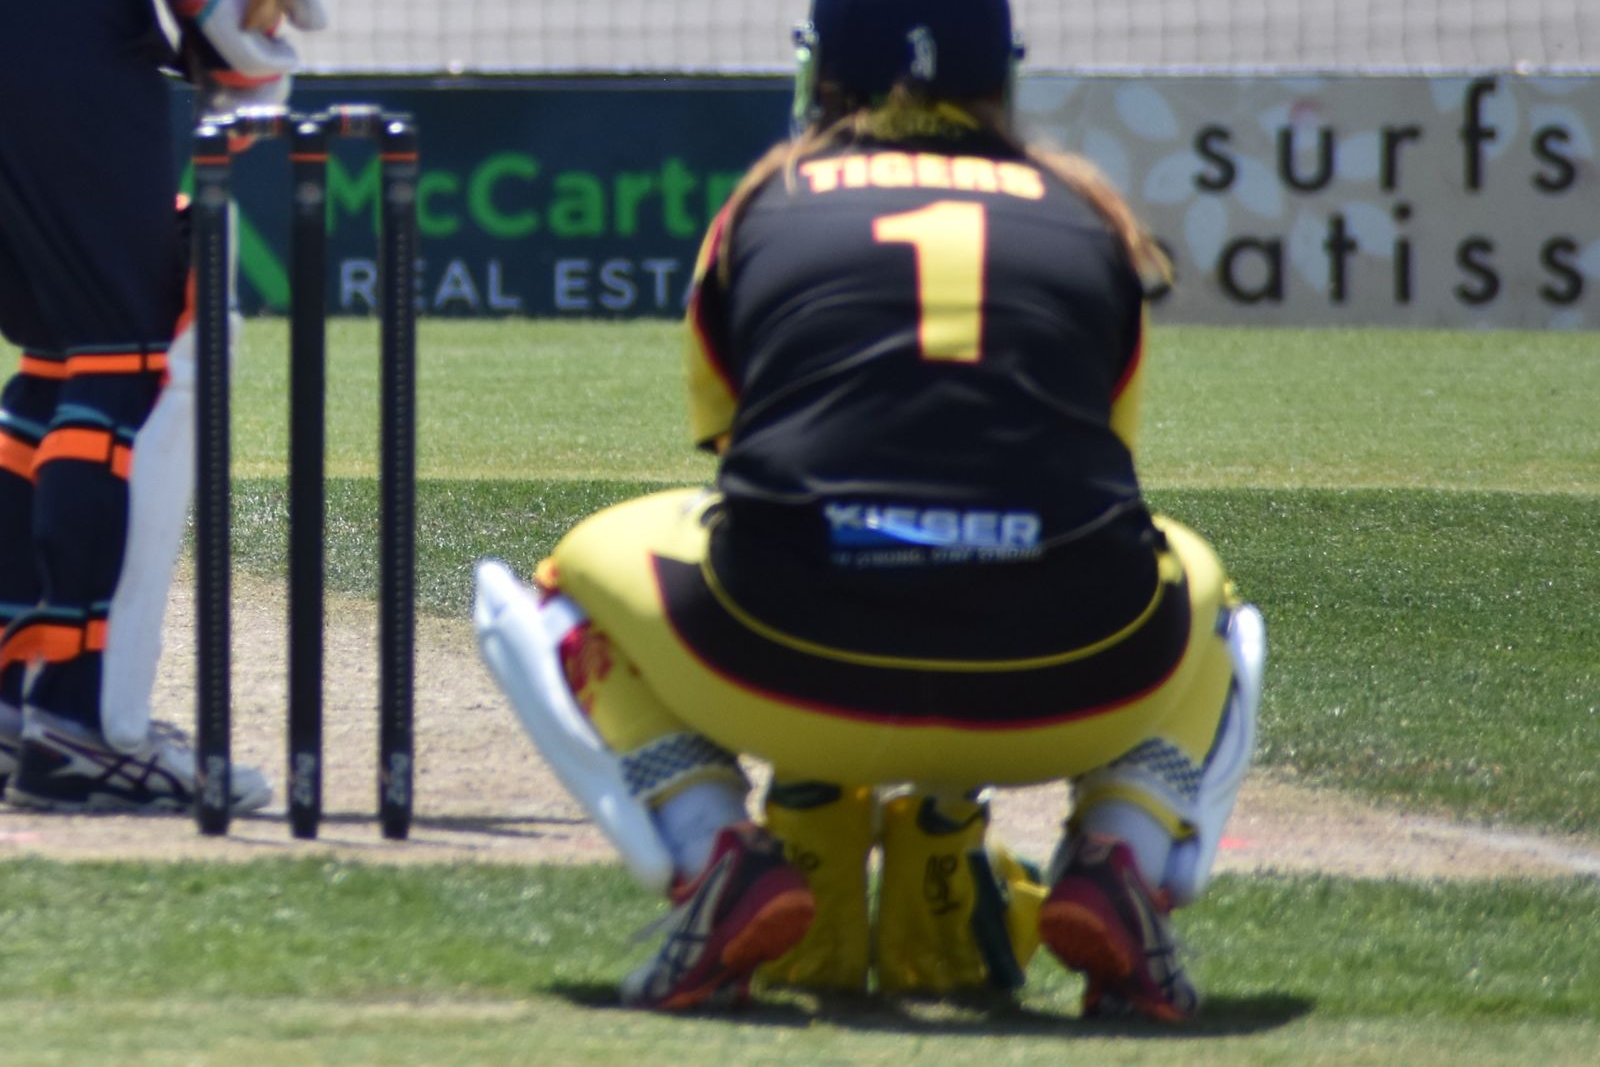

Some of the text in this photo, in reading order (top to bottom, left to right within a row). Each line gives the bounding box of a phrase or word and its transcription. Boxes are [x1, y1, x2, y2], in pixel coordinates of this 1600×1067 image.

[338, 258, 700, 308] RAL EST
[871, 200, 986, 364] 1
